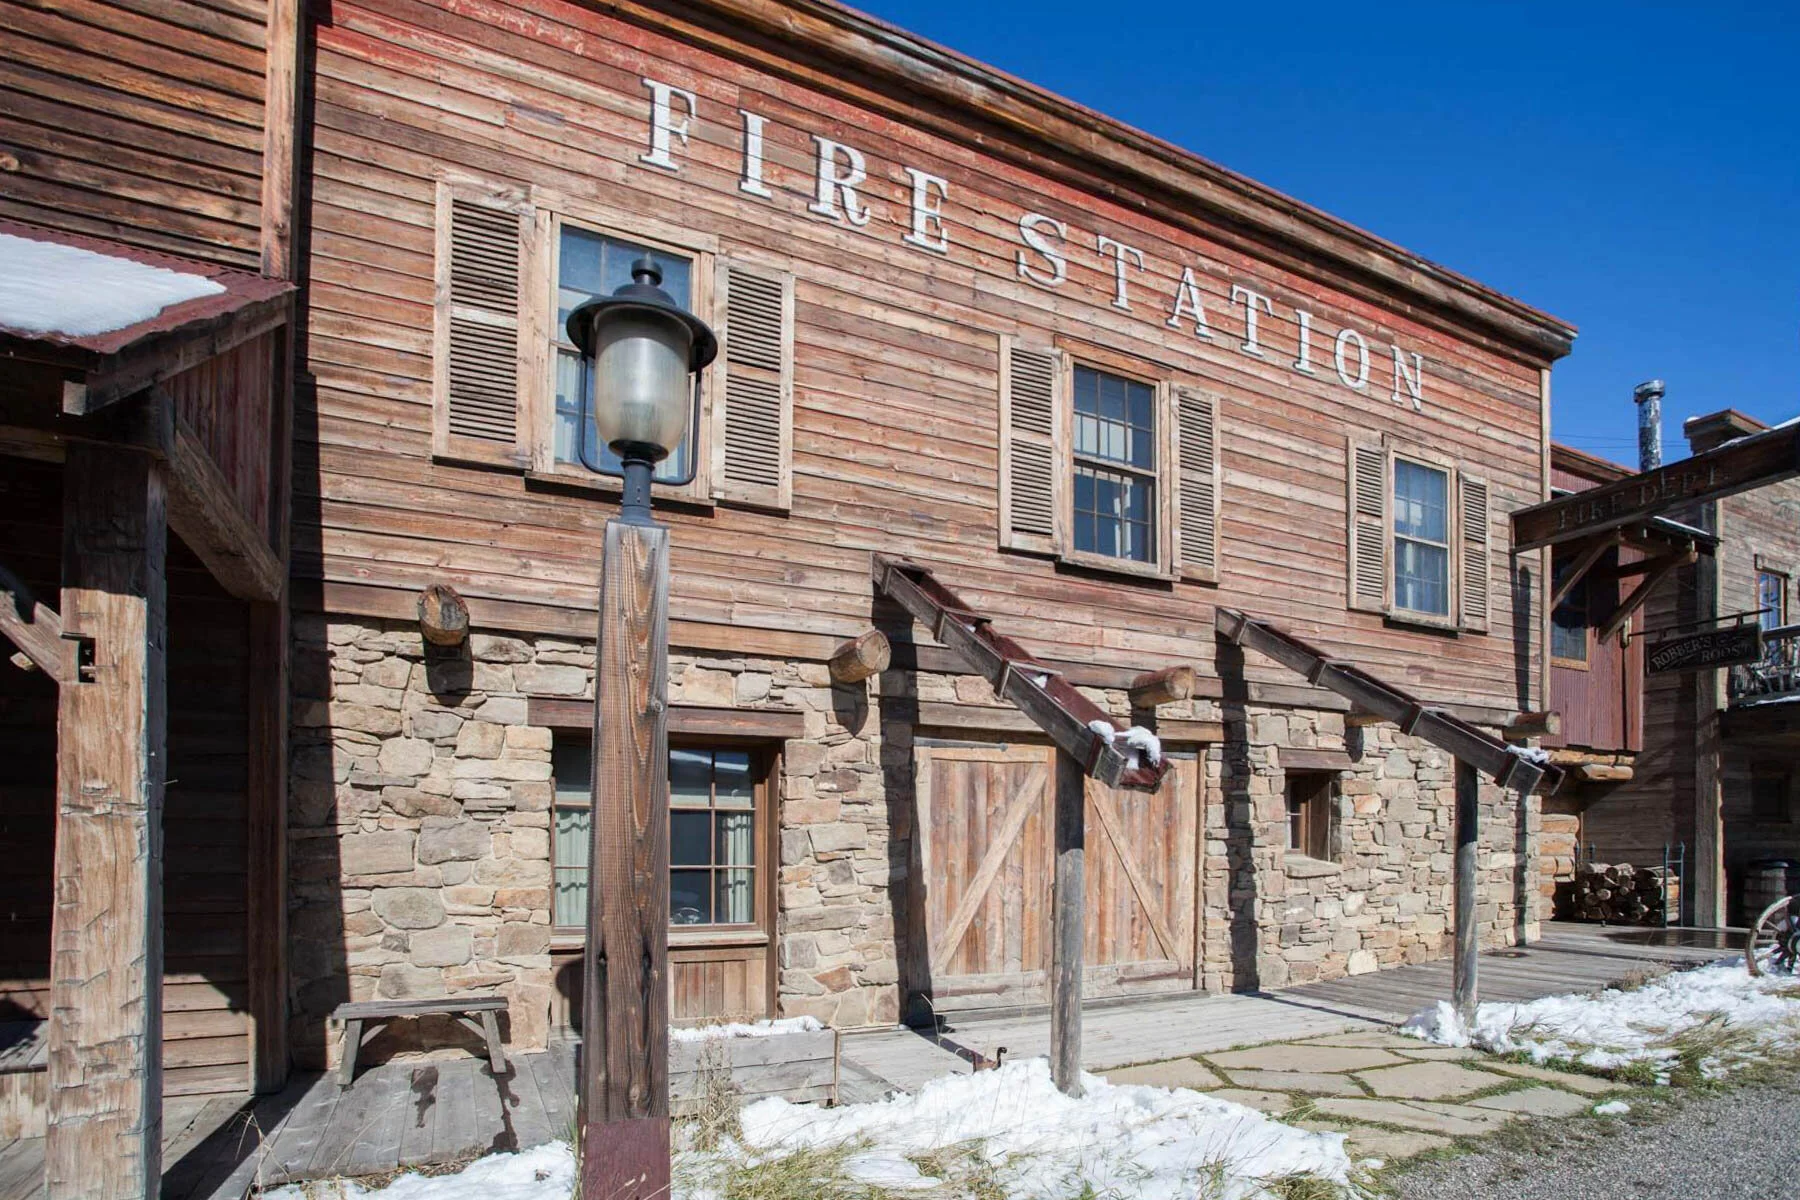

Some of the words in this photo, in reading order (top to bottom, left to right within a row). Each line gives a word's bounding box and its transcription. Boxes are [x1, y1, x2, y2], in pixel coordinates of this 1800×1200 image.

[638, 77, 949, 255] FIRE
[1015, 212, 1424, 412] STATION
[1559, 491, 1626, 530] FIRE
[1651, 636, 1713, 670] ROBBER'S
[1701, 643, 1753, 663] ROOST
